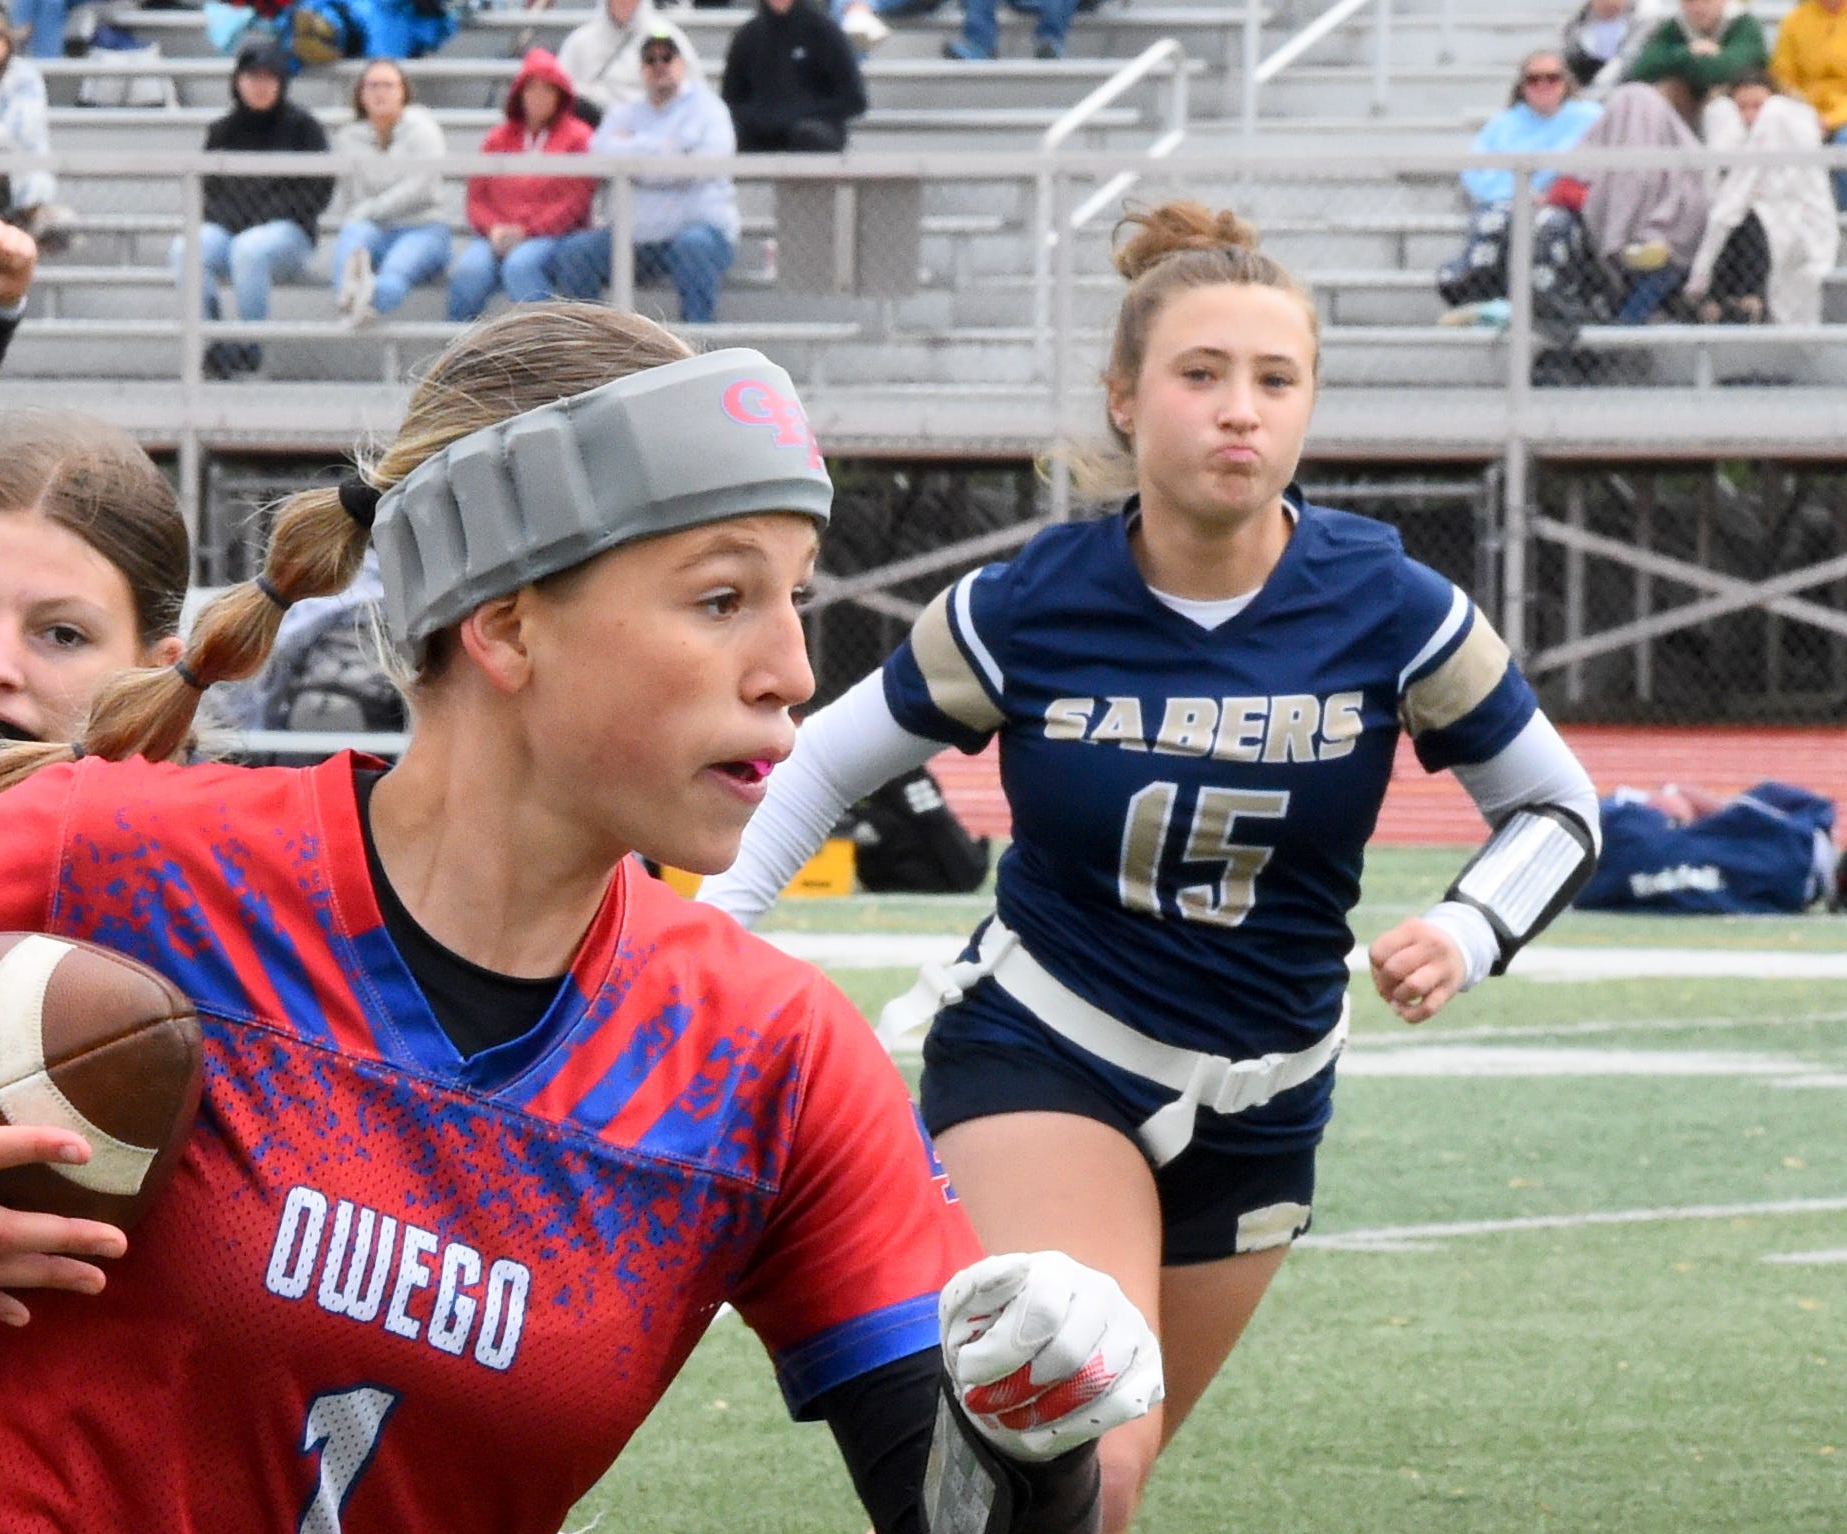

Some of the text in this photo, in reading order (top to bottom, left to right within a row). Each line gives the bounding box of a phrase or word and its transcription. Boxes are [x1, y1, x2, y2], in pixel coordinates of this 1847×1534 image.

[1043, 691, 1364, 763] SABERS
[1118, 781, 1290, 927] 15
[265, 1185, 531, 1371] OWEGO
